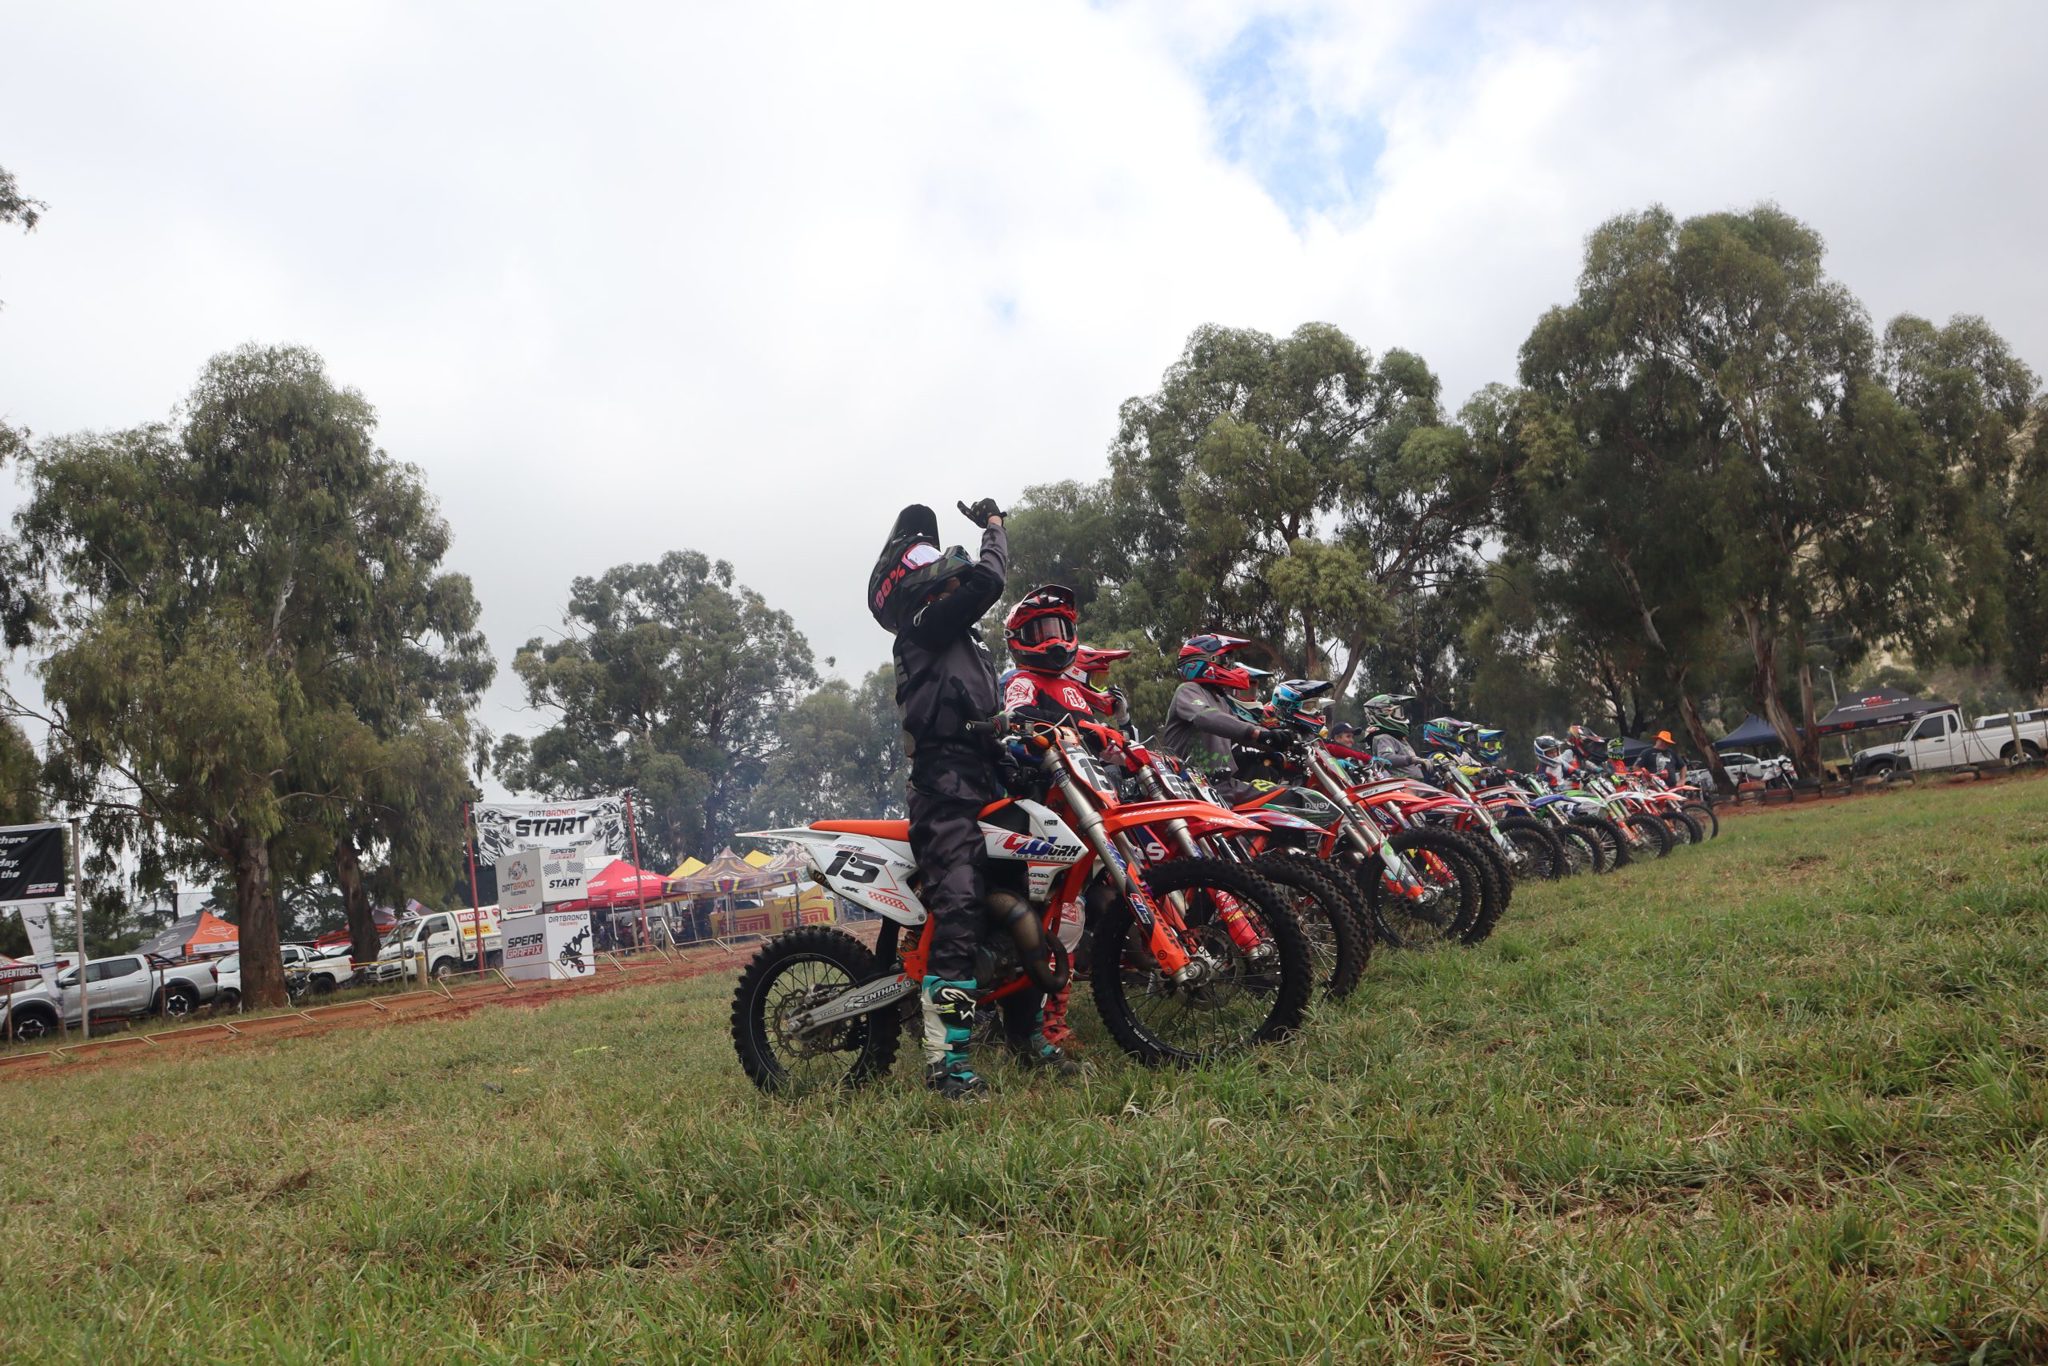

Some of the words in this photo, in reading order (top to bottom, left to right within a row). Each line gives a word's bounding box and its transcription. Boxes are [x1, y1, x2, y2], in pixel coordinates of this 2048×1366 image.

[875, 564, 906, 609] 00%
[515, 816, 590, 837] START
[825, 851, 888, 883] 15
[549, 878, 581, 889] START
[548, 914, 588, 923] DIRTBRONCO
[507, 933, 544, 948] SPEAR
[505, 944, 544, 959] GRAFFIX
